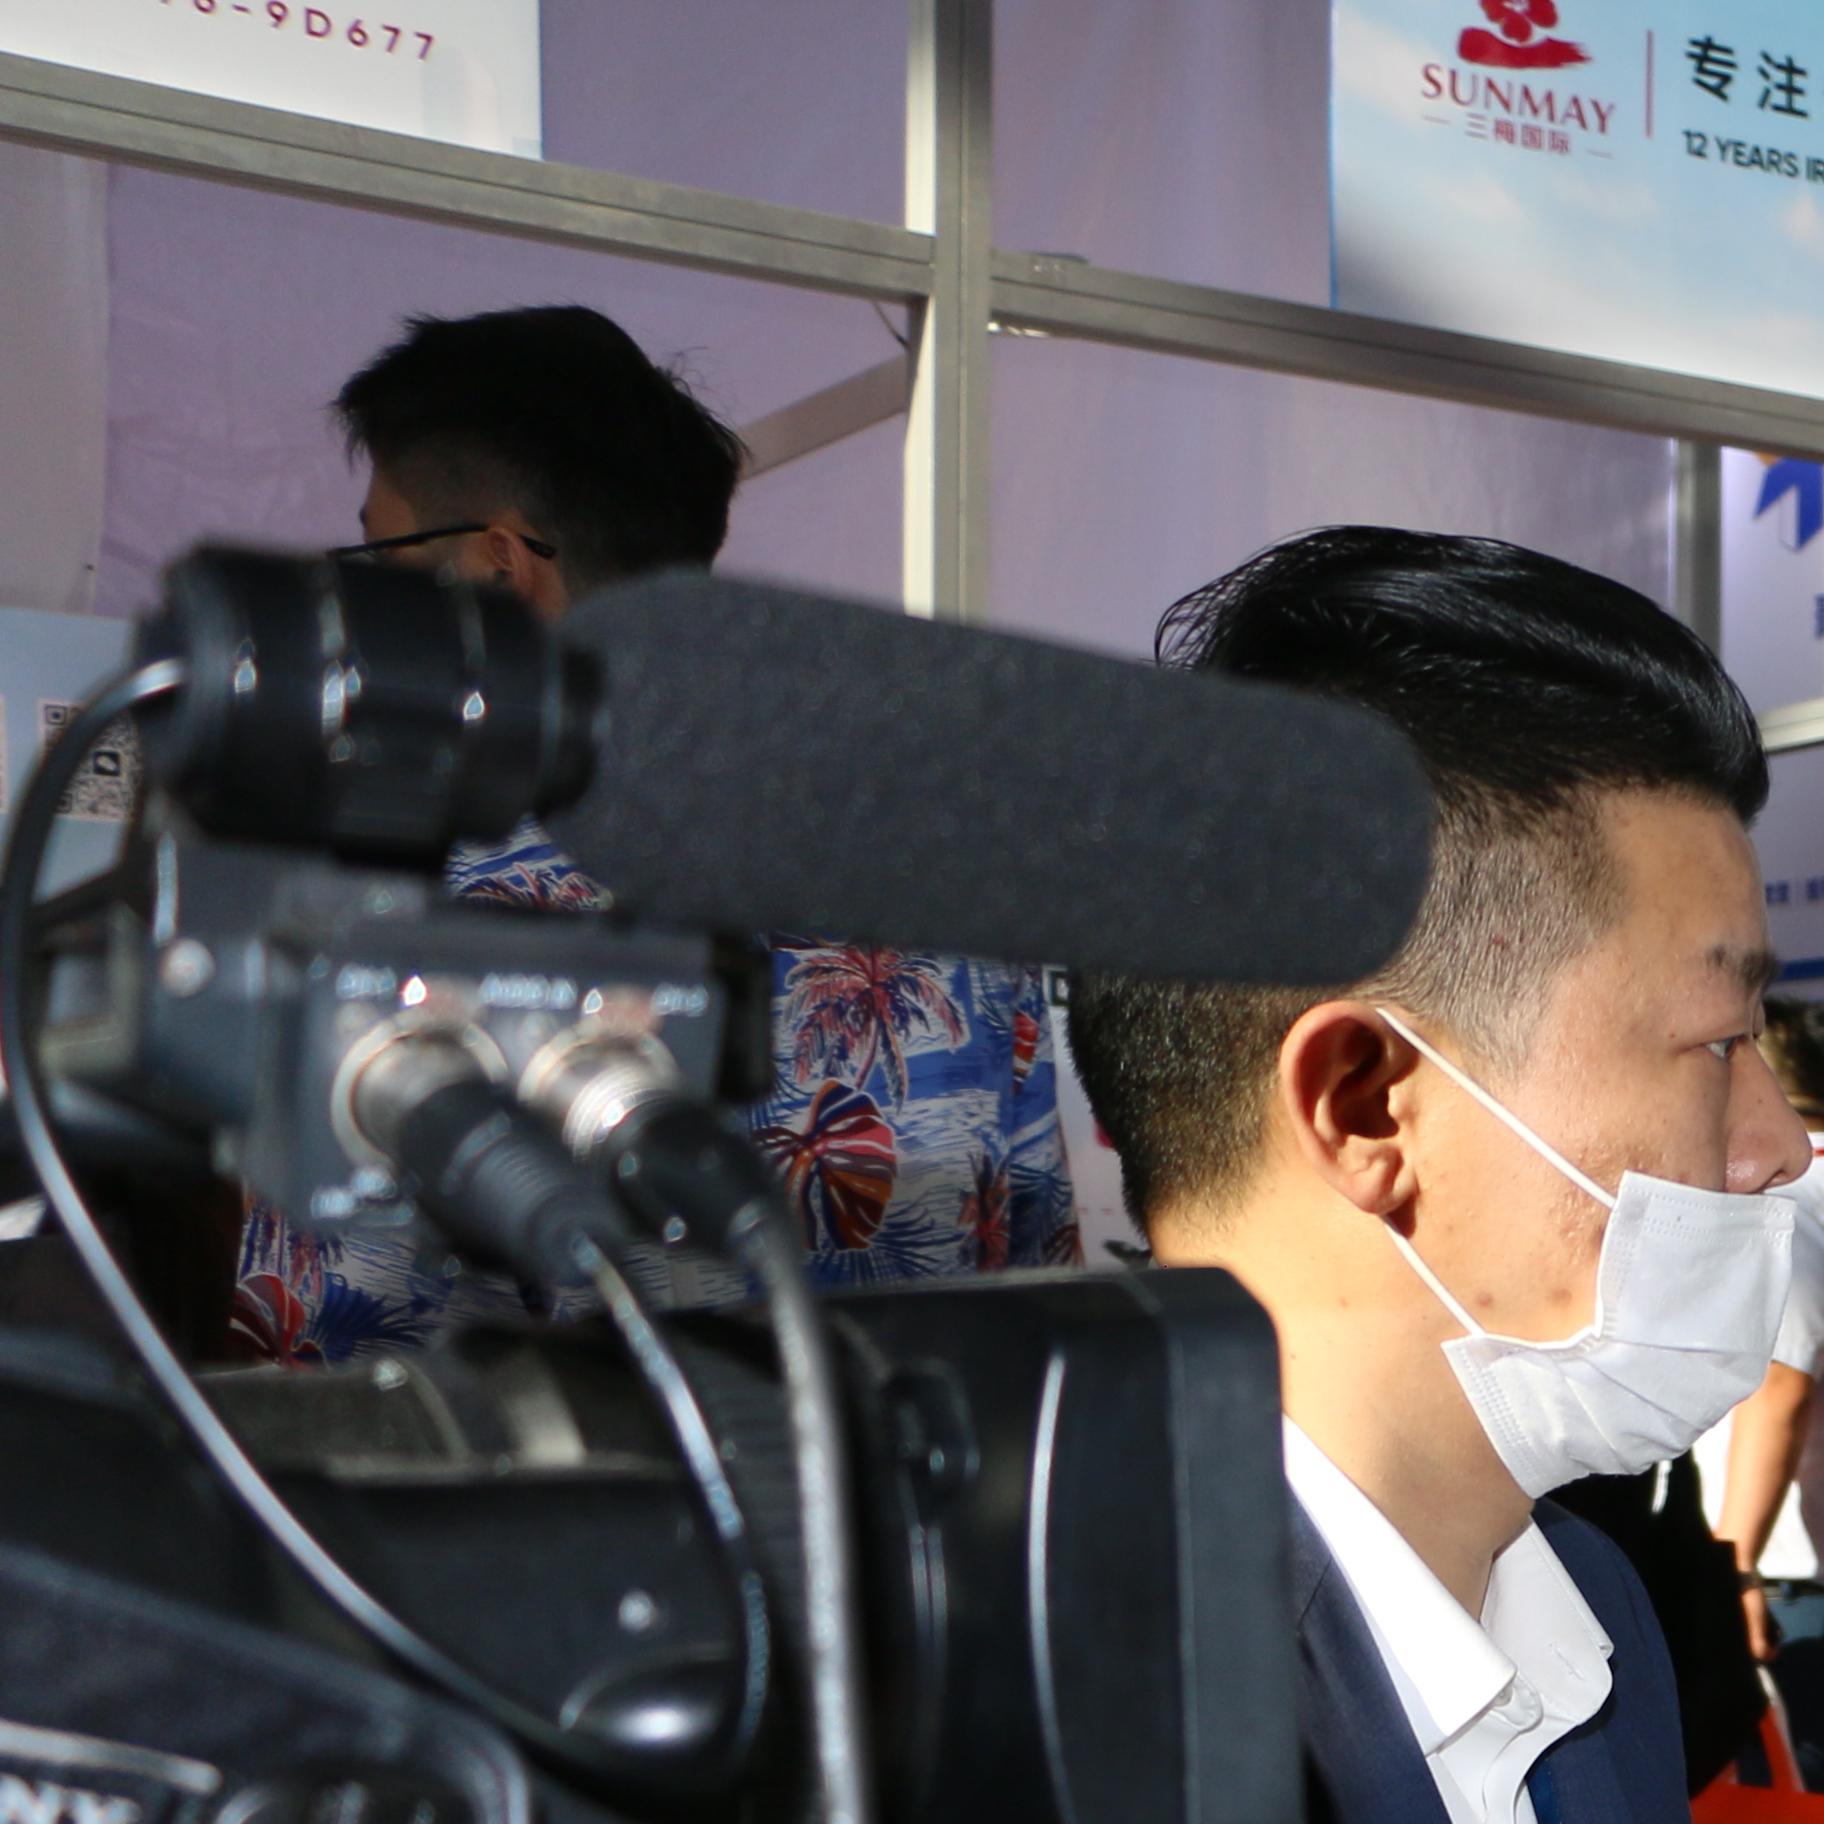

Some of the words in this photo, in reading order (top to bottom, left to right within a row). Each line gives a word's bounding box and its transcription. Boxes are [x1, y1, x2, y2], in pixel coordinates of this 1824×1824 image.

[1420, 64, 1616, 136] SUNMAY
[1683, 130, 1708, 159] 12
[1714, 139, 1800, 178] YEARS
